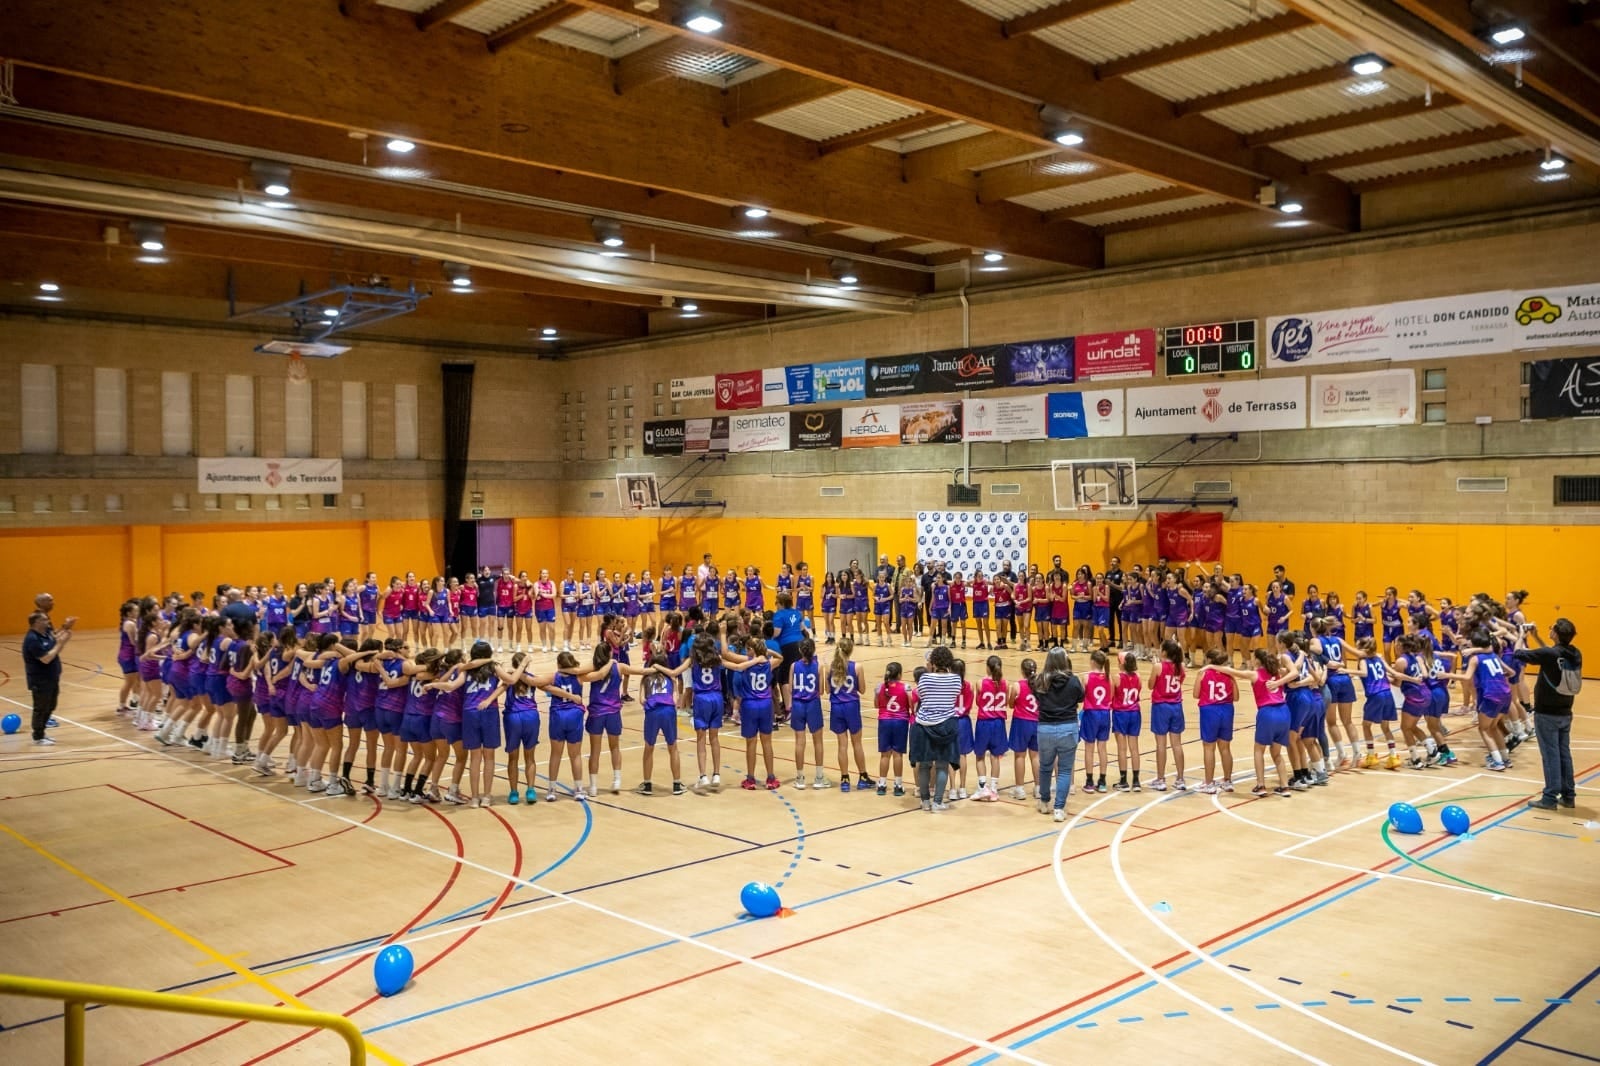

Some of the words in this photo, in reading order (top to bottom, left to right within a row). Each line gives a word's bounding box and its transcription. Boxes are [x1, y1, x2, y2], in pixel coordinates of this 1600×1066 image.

[1395, 315, 1429, 326] HOTEL
[1433, 312, 1455, 323] DON
[1459, 306, 1509, 320] CANDIDO
[1186, 326, 1222, 344] 00:0
[1271, 319, 1312, 360] jet
[1087, 345, 1140, 360] windat
[1172, 349, 1190, 358] LOCAL
[1226, 344, 1250, 353] VISITANT
[931, 357, 964, 372] Jamón
[977, 355, 995, 367] Art
[1185, 356, 1194, 372] 0
[1241, 352, 1251, 368] 0
[814, 366, 864, 378] Brumbrum
[880, 366, 897, 375] PUNT
[840, 377, 864, 392] LOL
[1135, 406, 1196, 419] Ajuntament
[1228, 402, 1242, 413] de
[1246, 400, 1297, 412] Terrassa
[736, 415, 785, 430] sermatec
[850, 425, 890, 434] HERCAL
[655, 428, 684, 437] GLOBAL
[206, 473, 261, 483] Ajuntament
[286, 474, 297, 482] de
[300, 473, 337, 482] Terrassa
[1325, 643, 1342, 661] 10
[271, 658, 278, 675] 9
[1369, 662, 1385, 680] 13
[1482, 658, 1504, 676] 14
[701, 667, 714, 685] 8
[750, 672, 767, 691] 18
[793, 673, 816, 692] 43
[1165, 675, 1180, 693] 15
[410, 677, 422, 697] 16
[1093, 686, 1106, 705] 9
[1123, 687, 1138, 705] 10
[1207, 680, 1228, 700] 13
[886, 695, 899, 712] 6
[982, 692, 1007, 712] 22
[1026, 694, 1038, 713] 3
